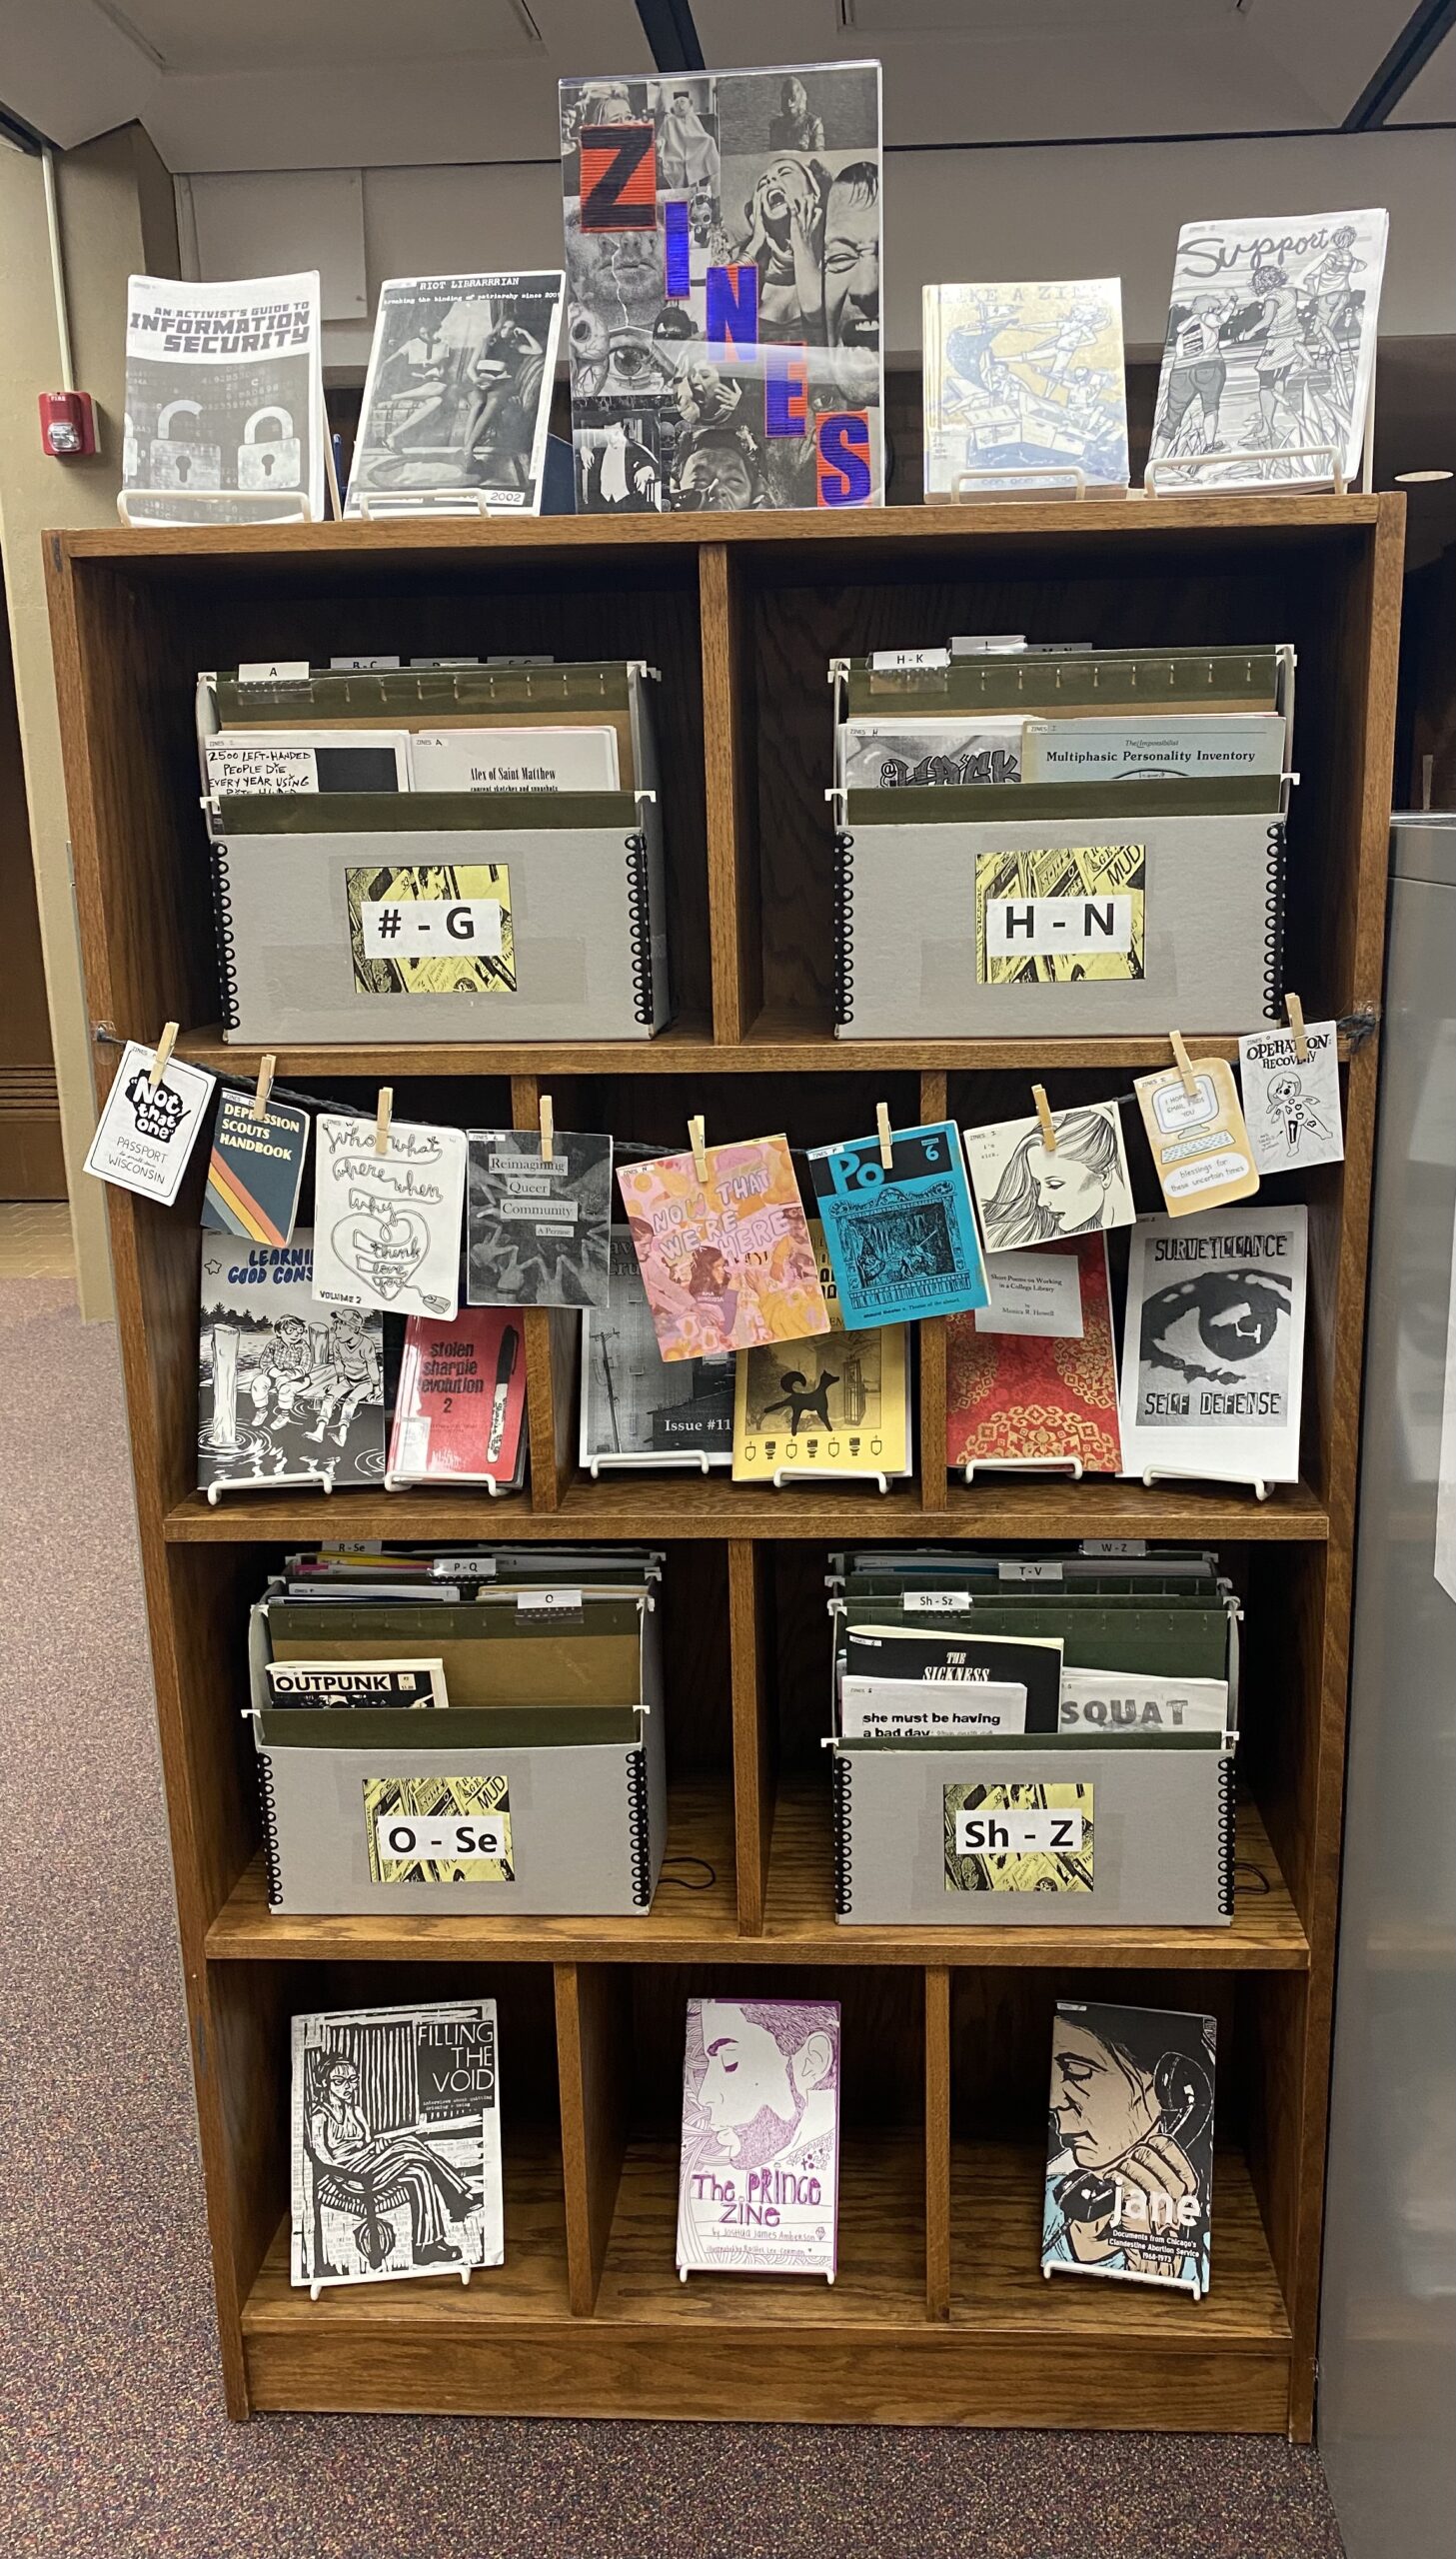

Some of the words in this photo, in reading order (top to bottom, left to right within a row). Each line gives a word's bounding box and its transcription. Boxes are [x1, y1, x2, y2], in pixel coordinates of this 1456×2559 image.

[1177, 227, 1330, 278] Support
[419, 281, 447, 291] RIOT
[451, 277, 520, 290] LIBRARRRIAN
[477, 292, 519, 301] patriarchy
[154, 307, 173, 317] AN
[176, 308, 248, 319] ACTIVIST'S
[251, 303, 290, 316] GUIDE
[293, 301, 310, 310] TO
[130, 310, 310, 335] INFORMATION
[163, 325, 310, 354] SECURITY
[490, 491, 523, 503] 2002
[369, 660, 378, 669] C
[896, 655, 905, 665] H
[915, 654, 923, 663] K
[269, 667, 278, 677] A
[208, 751, 239, 762] 2500
[241, 750, 311, 763] LEFT-HANDED
[1046, 751, 1118, 763] Multiphasic
[1122, 750, 1192, 764] Personality
[1196, 750, 1256, 763] Inventory
[223, 764, 263, 776] PEOPLE
[470, 767, 487, 781] Alex
[488, 767, 497, 781] of
[498, 767, 520, 781] Saint
[521, 767, 556, 781] Matthew
[209, 778, 241, 789] EVERY
[243, 777, 273, 787] YEAR
[1106, 845, 1141, 887] MUD
[378, 909, 402, 939] #
[446, 907, 475, 940] G
[1005, 905, 1034, 939] H
[1083, 903, 1114, 937] N
[137, 1103, 177, 1129] that
[221, 1118, 271, 1140] SCOUTS
[116, 1136, 169, 1165] PASSPORT
[219, 1133, 293, 1162] HANDBOOK
[924, 1145, 940, 1162] 6
[108, 1154, 165, 1185] WISCONSIN
[826, 1152, 885, 1197] Po
[1179, 1164, 1212, 1179] blessings
[509, 1181, 549, 1194] Queer
[1170, 1182, 1189, 1193] these
[1191, 1172, 1224, 1186] uncertain
[1225, 1165, 1244, 1176] times
[502, 1203, 574, 1217] Community
[652, 1192, 707, 1236] NOW
[716, 1168, 771, 1207] THAT
[717, 1207, 792, 1263] HERE
[248, 1248, 314, 1267] LEARNI
[1154, 1235, 1288, 1263] SURVEILLANCE
[227, 1265, 268, 1284] GOOD
[272, 1265, 313, 1284] CONS
[1035, 1278, 1063, 1286] Working
[320, 1289, 354, 1303] VOLUME
[355, 1295, 362, 1304] 2
[1010, 1282, 1032, 1291] College
[1033, 1284, 1055, 1293] Library
[430, 1340, 475, 1358] stolen
[423, 1358, 478, 1376] sharpie
[443, 1396, 454, 1414] 2
[1144, 1392, 1190, 1415] SELF
[1200, 1391, 1282, 1415] DEFENSE
[665, 1418, 703, 1432] Issue
[706, 1417, 731, 1431] #11
[354, 1543, 366, 1552] Se
[1100, 1543, 1112, 1552] W
[1120, 1543, 1127, 1552] Z
[454, 1562, 461, 1571] P
[469, 1561, 479, 1572] Q
[1018, 1566, 1026, 1576] T
[1034, 1566, 1042, 1576] V
[544, 1593, 554, 1604] O
[919, 1595, 932, 1607] Sh
[941, 1596, 954, 1606] Sz
[946, 1651, 967, 1664] THE
[275, 1675, 390, 1691] OUTPUNK
[921, 1666, 990, 1682] SICKNESS
[862, 1712, 888, 1723] she
[891, 1713, 928, 1723] must
[931, 1712, 949, 1723] be
[952, 1712, 1000, 1726] having
[1060, 1698, 1189, 1727] SQUAT
[874, 1727, 901, 1737] bad
[477, 1775, 506, 1810] MUD
[388, 1826, 417, 1853] O
[455, 1826, 498, 1853] Se
[964, 1819, 1009, 1848] Sh
[1049, 1819, 1073, 1847] Z
[418, 2021, 494, 2046] FILLING
[451, 2045, 493, 2069] THE
[432, 2068, 495, 2093] VOID
[691, 2172, 735, 2202] The
[1112, 2229, 1148, 2241] Documents
[1149, 2234, 1165, 2244] from
[1166, 2237, 1197, 2248] Chicago's
[1109, 2238, 1146, 2250] Clandestine
[1147, 2243, 1174, 2254] Abortion
[1175, 2247, 1200, 2258] Service
[1142, 2251, 1172, 2262] 1968-1973
